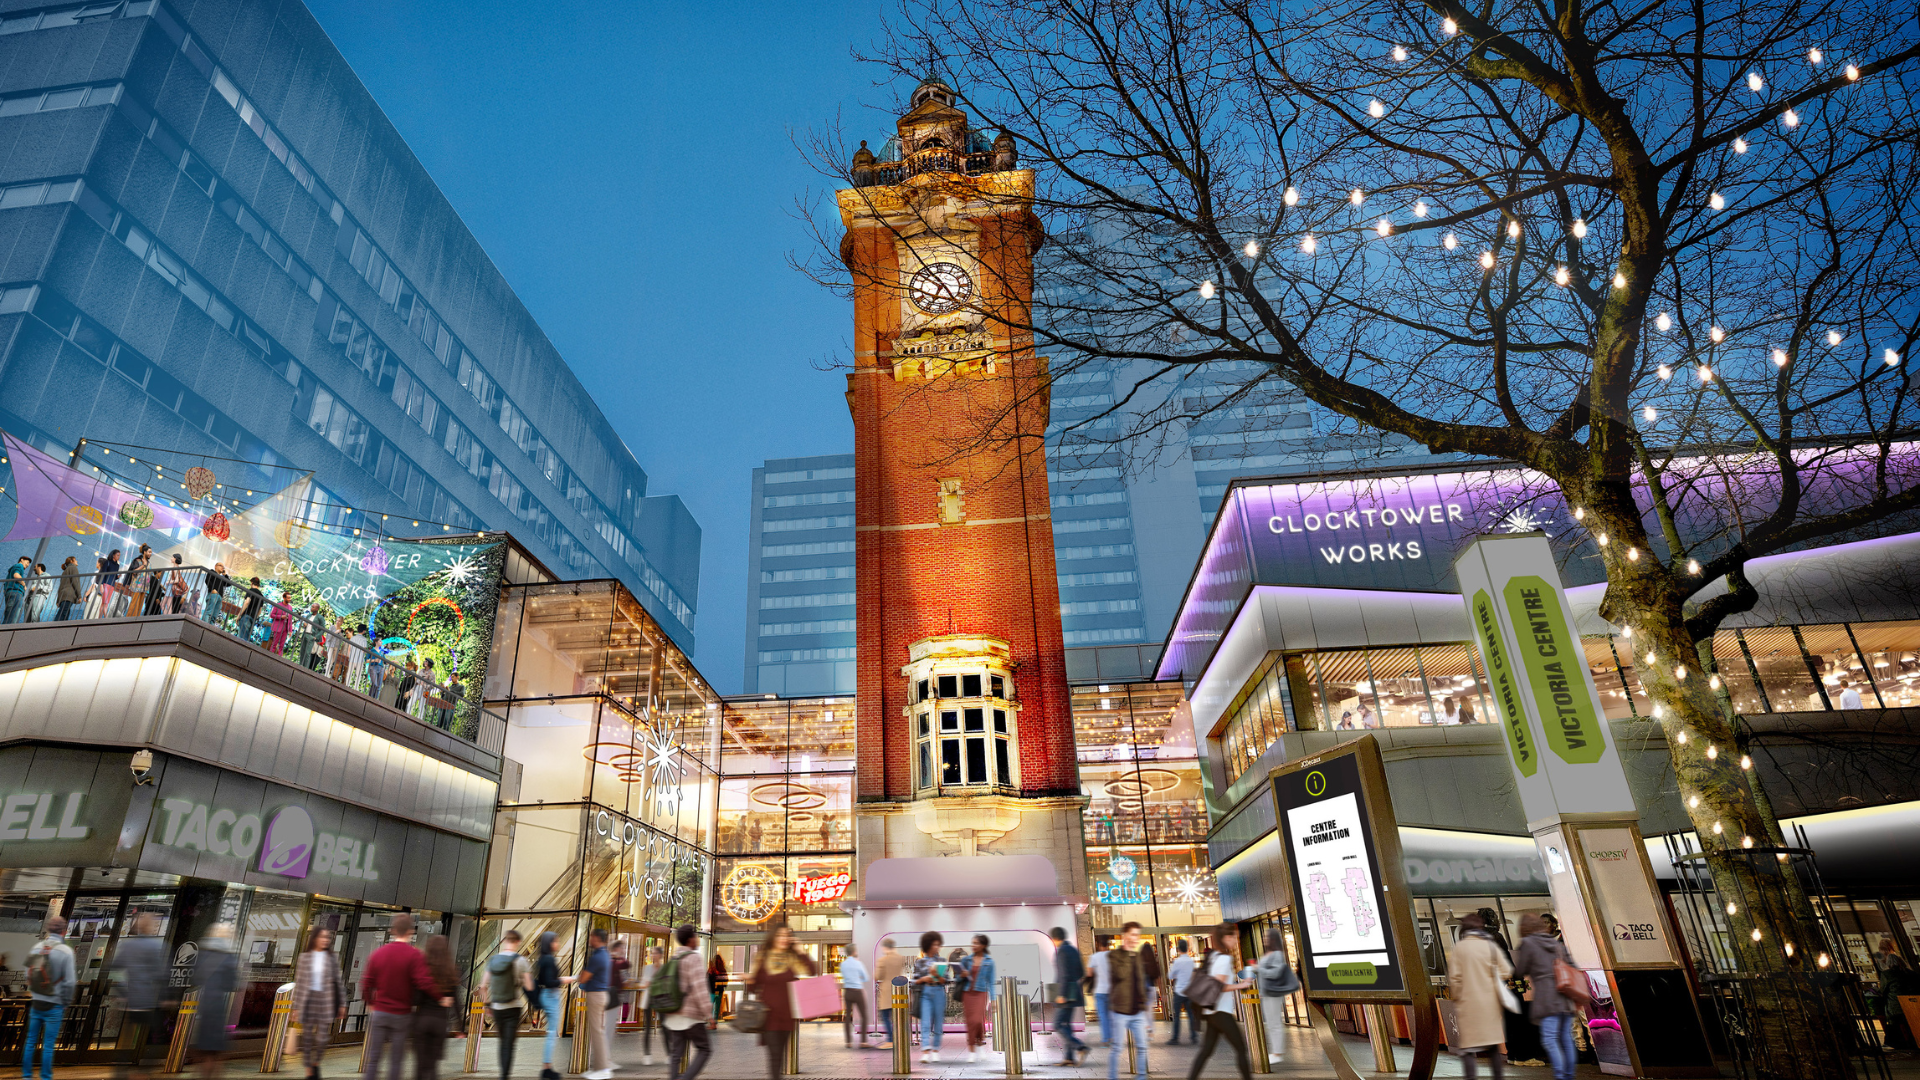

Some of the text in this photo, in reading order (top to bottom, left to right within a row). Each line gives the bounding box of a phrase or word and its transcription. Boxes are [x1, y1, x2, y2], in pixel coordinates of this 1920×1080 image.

[1269, 504, 1464, 533] CLOCKTOWER
[1320, 542, 1421, 564] WORKS
[301, 585, 376, 602] WORKS
[1520, 588, 1587, 750] VICTORIA CENTRE
[1477, 601, 1529, 763] VICTORIA CENTRE
[0, 793, 88, 840] ELL
[1311, 820, 1337, 834] CENTRE
[163, 798, 378, 880] TACO BELL
[596, 811, 707, 874] CLOCKTOWER
[1302, 828, 1350, 847] INFORMATION
[729, 868, 774, 887] HOUSE
[627, 871, 684, 906] WORKS
[805, 885, 847, 903] 1987
[1096, 881, 1150, 902] Baity
[727, 898, 776, 919] HABESHA
[1628, 923, 1654, 932] TACO
[1633, 932, 1657, 940] BELL
[170, 968, 195, 978] TACO
[1331, 968, 1373, 977] VICTORIA CENTRE
[168, 978, 191, 988] BELL
